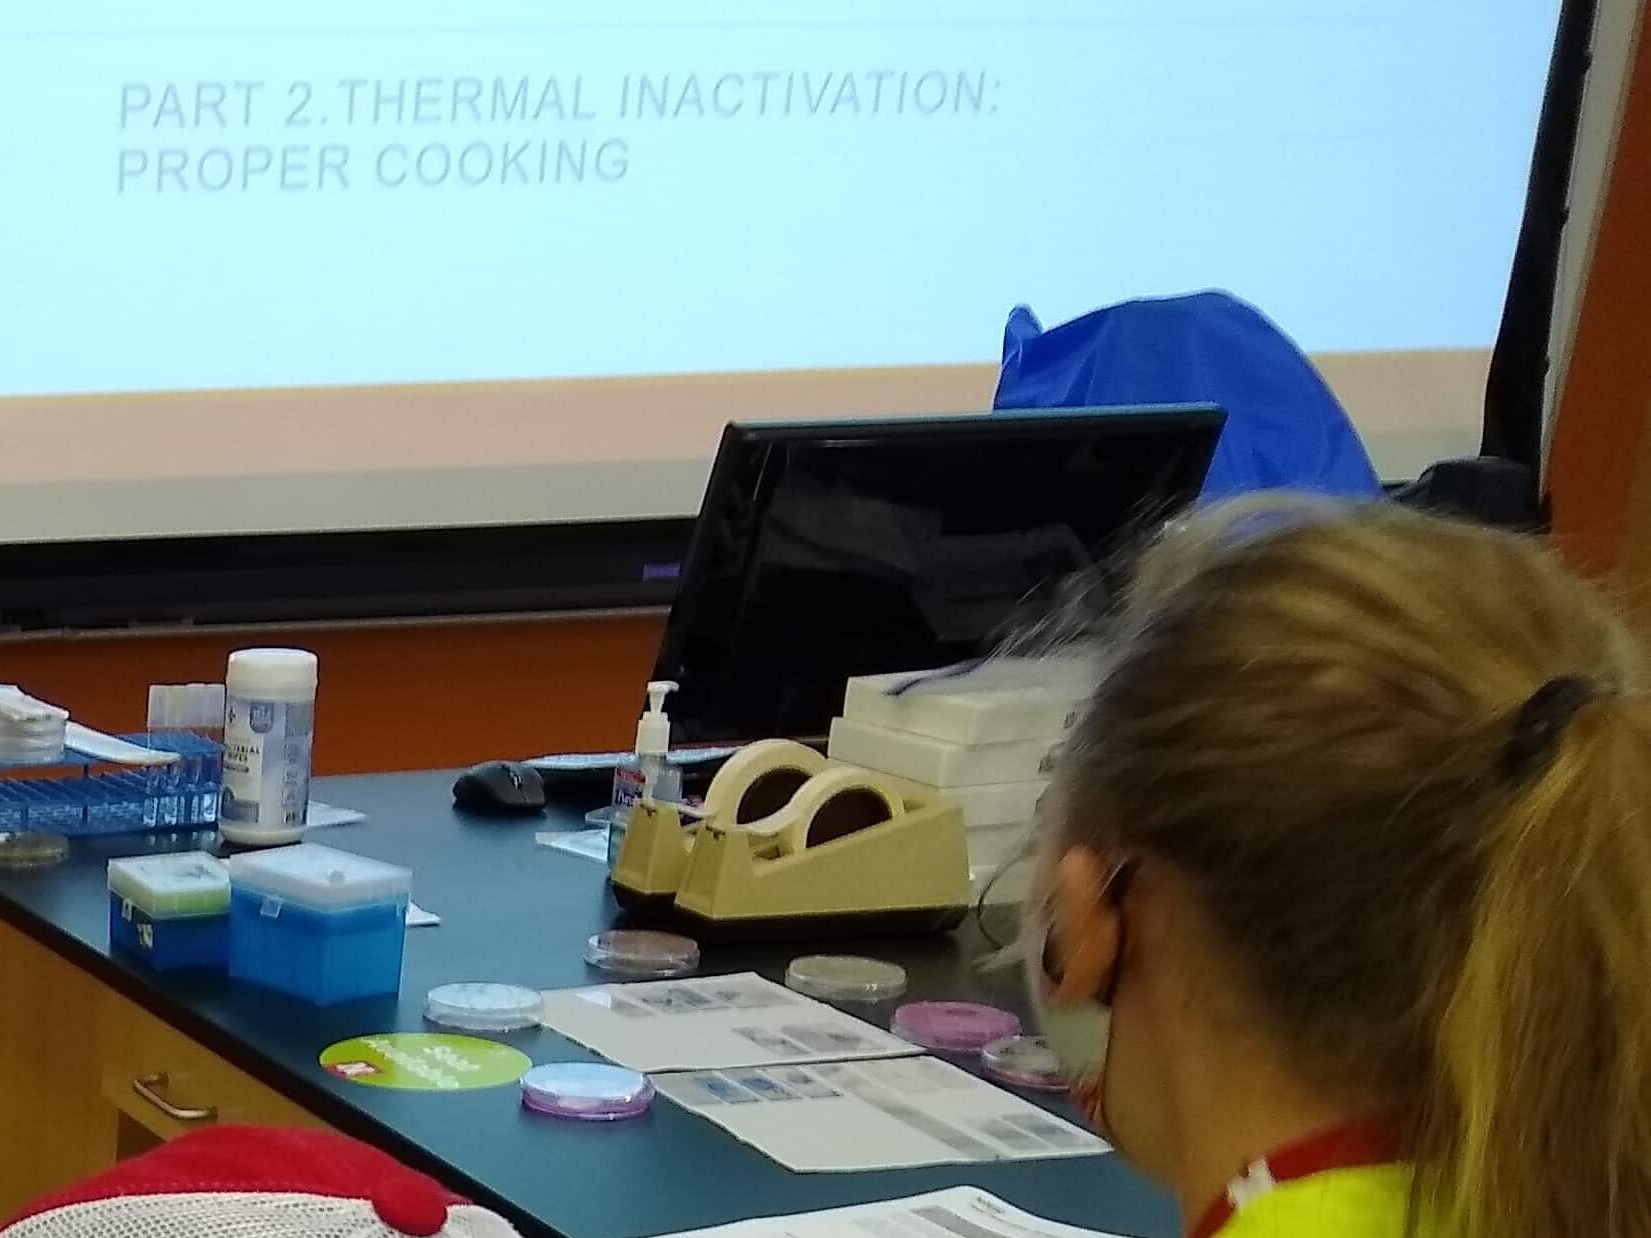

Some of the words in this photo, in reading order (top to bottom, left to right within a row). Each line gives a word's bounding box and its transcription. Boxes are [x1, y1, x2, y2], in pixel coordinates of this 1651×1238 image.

[119, 80, 266, 129] PART
[619, 68, 1002, 120] INACTIVATION:
[116, 144, 351, 194] PROPER
[374, 137, 631, 189] COOKING
